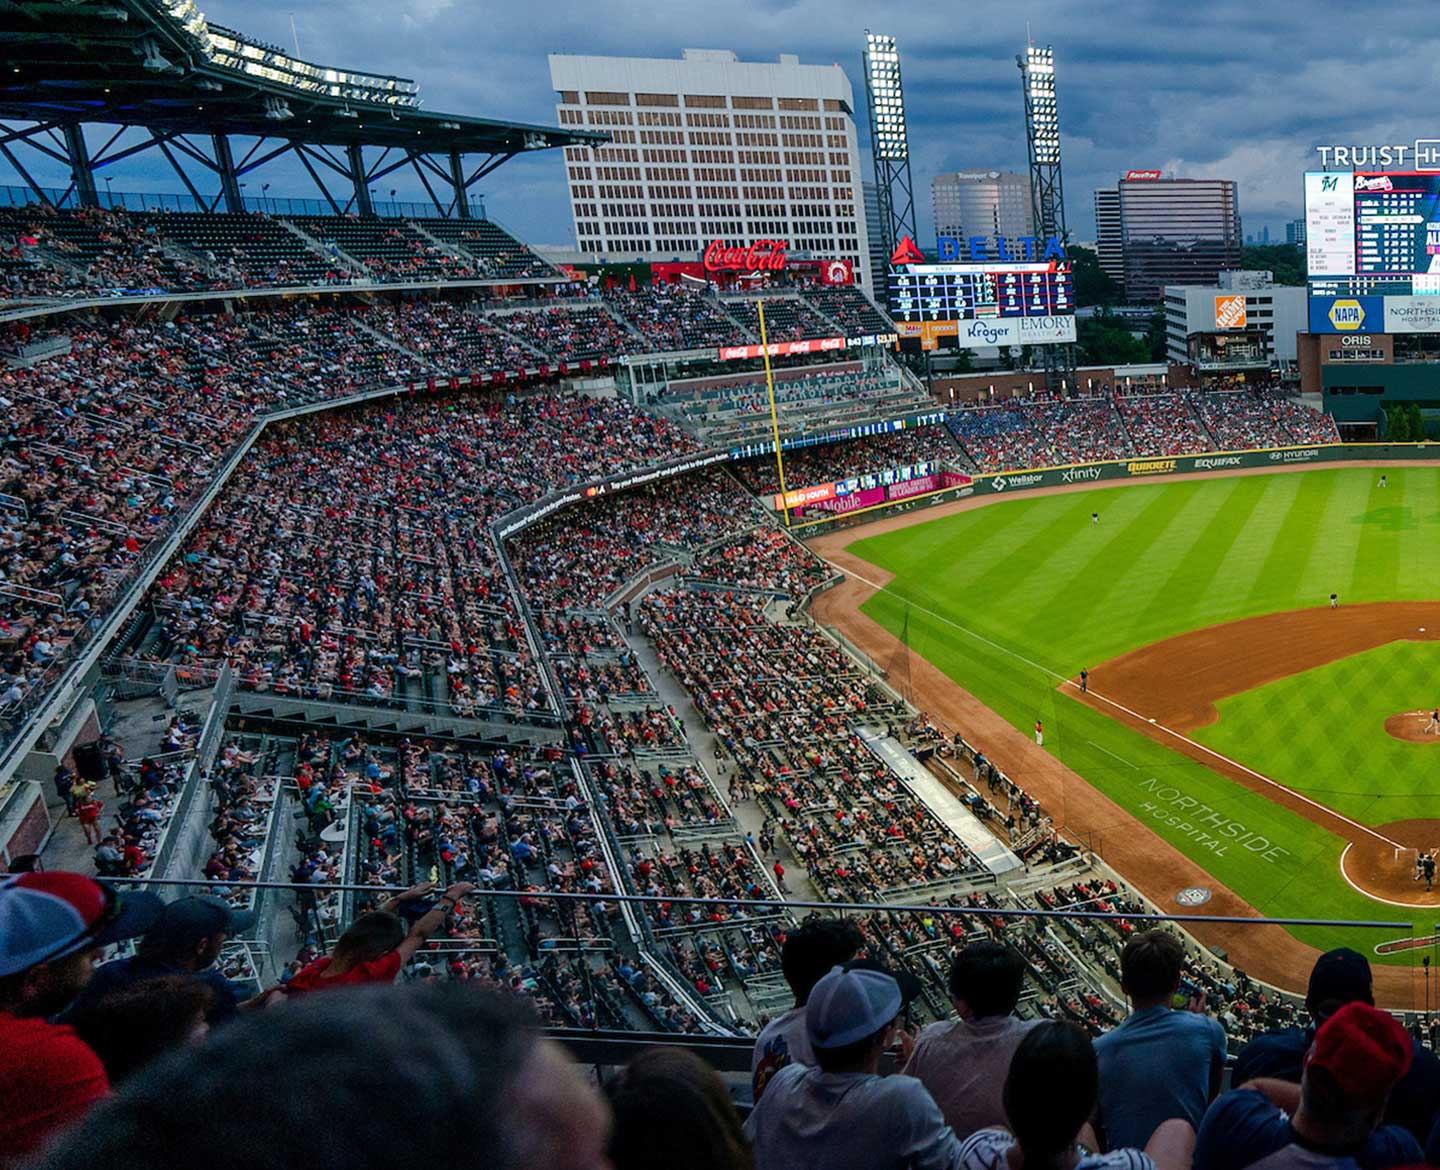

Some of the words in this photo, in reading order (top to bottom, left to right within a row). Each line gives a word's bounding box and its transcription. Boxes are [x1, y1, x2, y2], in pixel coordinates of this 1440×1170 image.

[1317, 146, 1409, 166] TRUIST
[703, 239, 789, 272] Coca-Cola
[936, 236, 1065, 261] DELTA
[1335, 307, 1360, 322] NAPA
[1021, 316, 1073, 330] EMORY
[968, 321, 1010, 343] Kroger
[1342, 336, 1371, 345] ORIS
[1283, 450, 1318, 458] HYUNDAI
[1127, 460, 1177, 472] QUIKRETE
[1194, 457, 1242, 469] EQUIFAX
[1008, 474, 1043, 485] Wellstar
[1062, 467, 1102, 483] xfinity
[1138, 777, 1291, 864] NORTHSIDE
[1138, 800, 1229, 857] HOSPITAL
